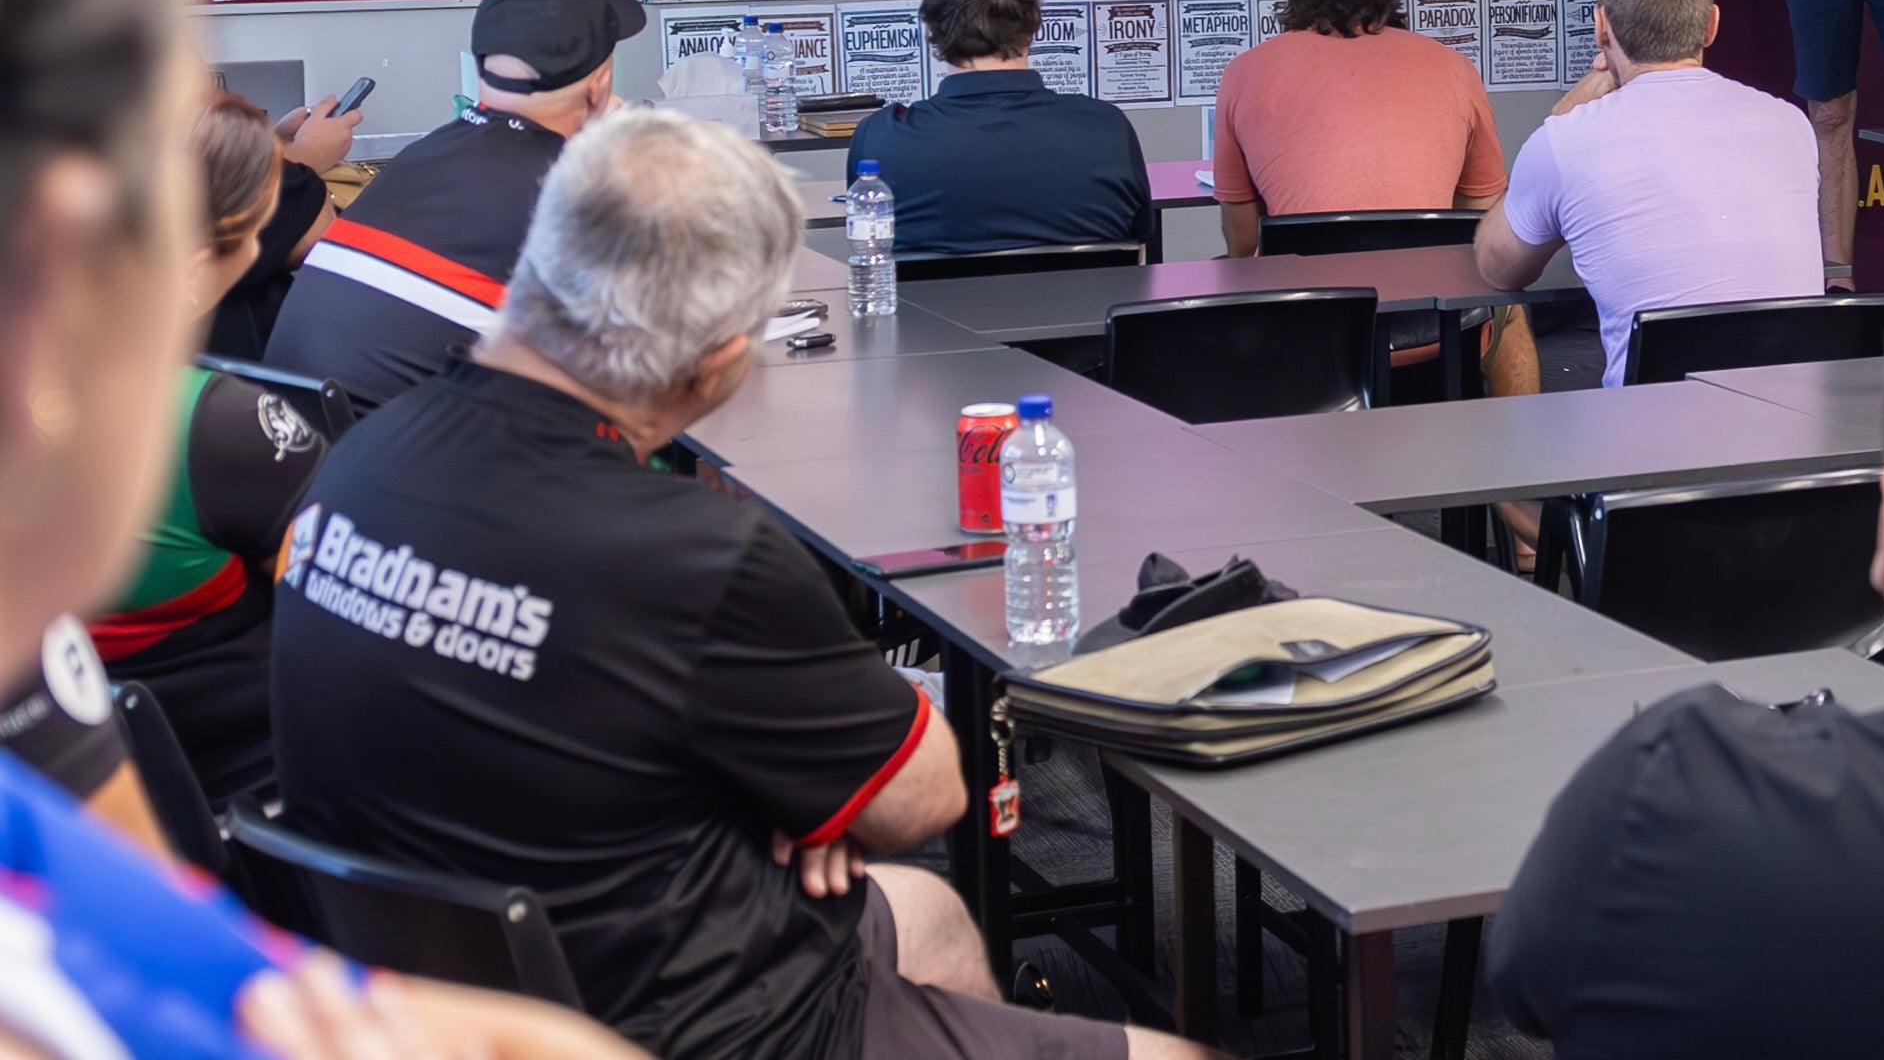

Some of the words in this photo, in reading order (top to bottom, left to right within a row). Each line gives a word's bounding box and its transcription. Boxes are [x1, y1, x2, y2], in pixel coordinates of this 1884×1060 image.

[1419, 8, 1477, 28] PARADOX
[1490, 4, 1557, 24] PERSONIFICATION
[1109, 20, 1155, 40] IRONY
[1182, 16, 1248, 34] METAPHOR
[846, 28, 919, 52] EUPHEMISM
[314, 512, 553, 648] Bradnam's
[305, 569, 406, 639] windows
[405, 612, 435, 648] &
[434, 624, 537, 682] doors
